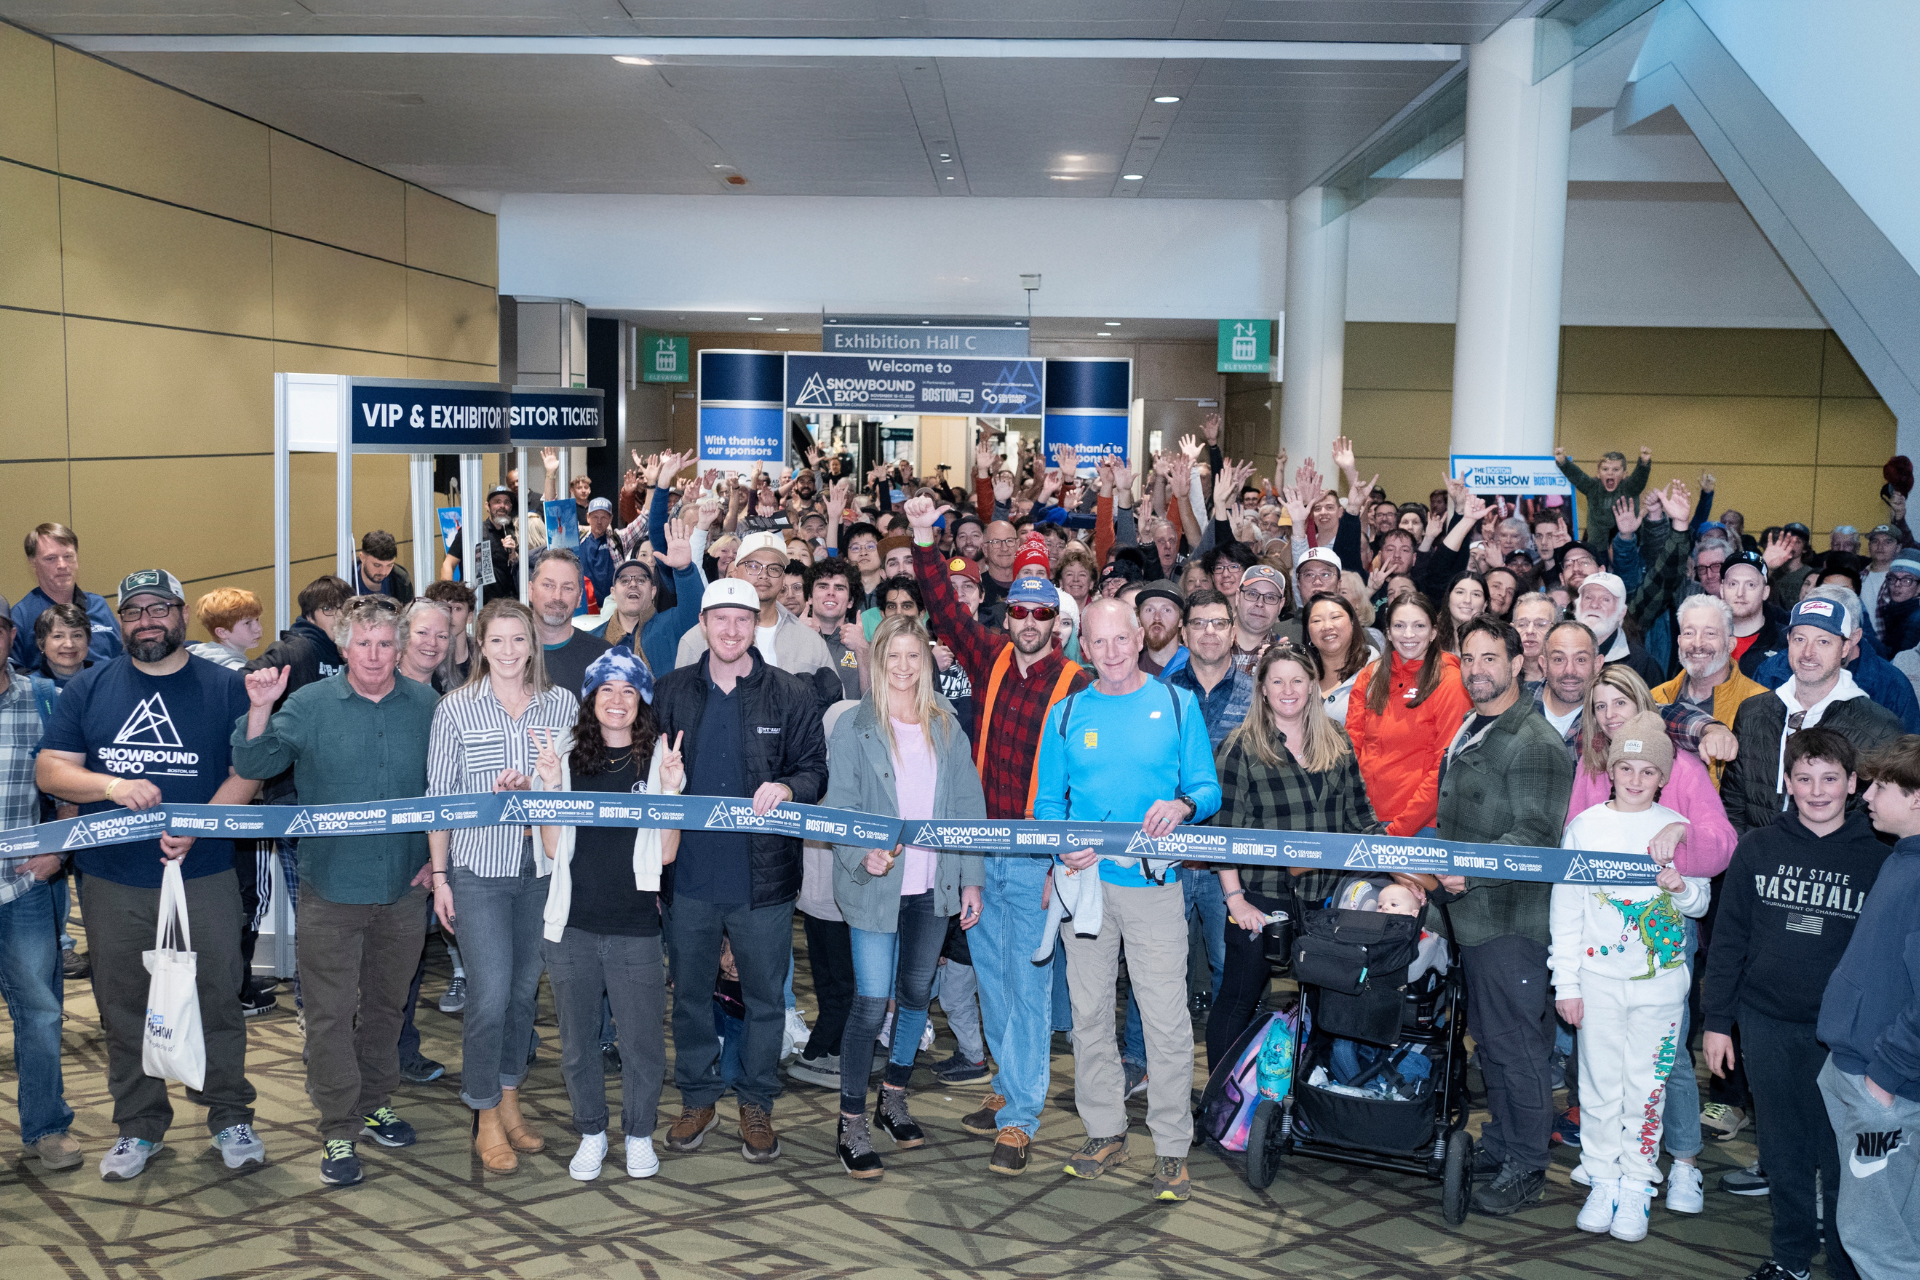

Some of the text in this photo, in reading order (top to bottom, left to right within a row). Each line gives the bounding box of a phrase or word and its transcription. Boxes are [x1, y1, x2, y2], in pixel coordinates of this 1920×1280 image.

[834, 334, 977, 350] Exhibition Hall C
[867, 360, 952, 373] Welcome to
[826, 378, 916, 391] SNOWBOUND
[834, 390, 869, 402] EXPO
[362, 403, 403, 428] VIP
[410, 404, 425, 428] &
[431, 405, 501, 429] EXHIBITOR
[561, 407, 598, 426] TICKETS
[704, 435, 778, 447] With thanks to
[725, 448, 772, 457] sponsors
[1075, 444, 1111, 453] thanks
[1113, 445, 1123, 453] to
[1475, 476, 1530, 486] RUN SHOW
[841, 650, 857, 665] A
[98, 748, 199, 765] SNOWBOUND
[106, 761, 144, 774] EXPO
[522, 800, 594, 810] SNOWBOUND
[312, 809, 386, 822] SNOWBOUND
[529, 810, 557, 818] EXPO
[730, 806, 801, 821] SNOBOUND
[89, 812, 166, 832] SNOWBOUND
[318, 820, 348, 830] EXPO
[736, 816, 765, 826] EXPO
[97, 826, 129, 840] EXPO
[936, 827, 1011, 837] SNOWBOUND
[944, 836, 972, 845] EXPO
[1158, 842, 1187, 852] EXPO
[1371, 844, 1447, 858] SNOWBOUND
[1378, 855, 1408, 866] EXPO
[1589, 859, 1662, 872] SNOWBOUND
[1597, 869, 1626, 879] EXPO
[1778, 864, 1850, 885] BAY STATE
[1755, 875, 1865, 914] BASEBALL
[1654, 1035, 1676, 1082] MERRY
[1856, 1127, 1902, 1157] NIKE
